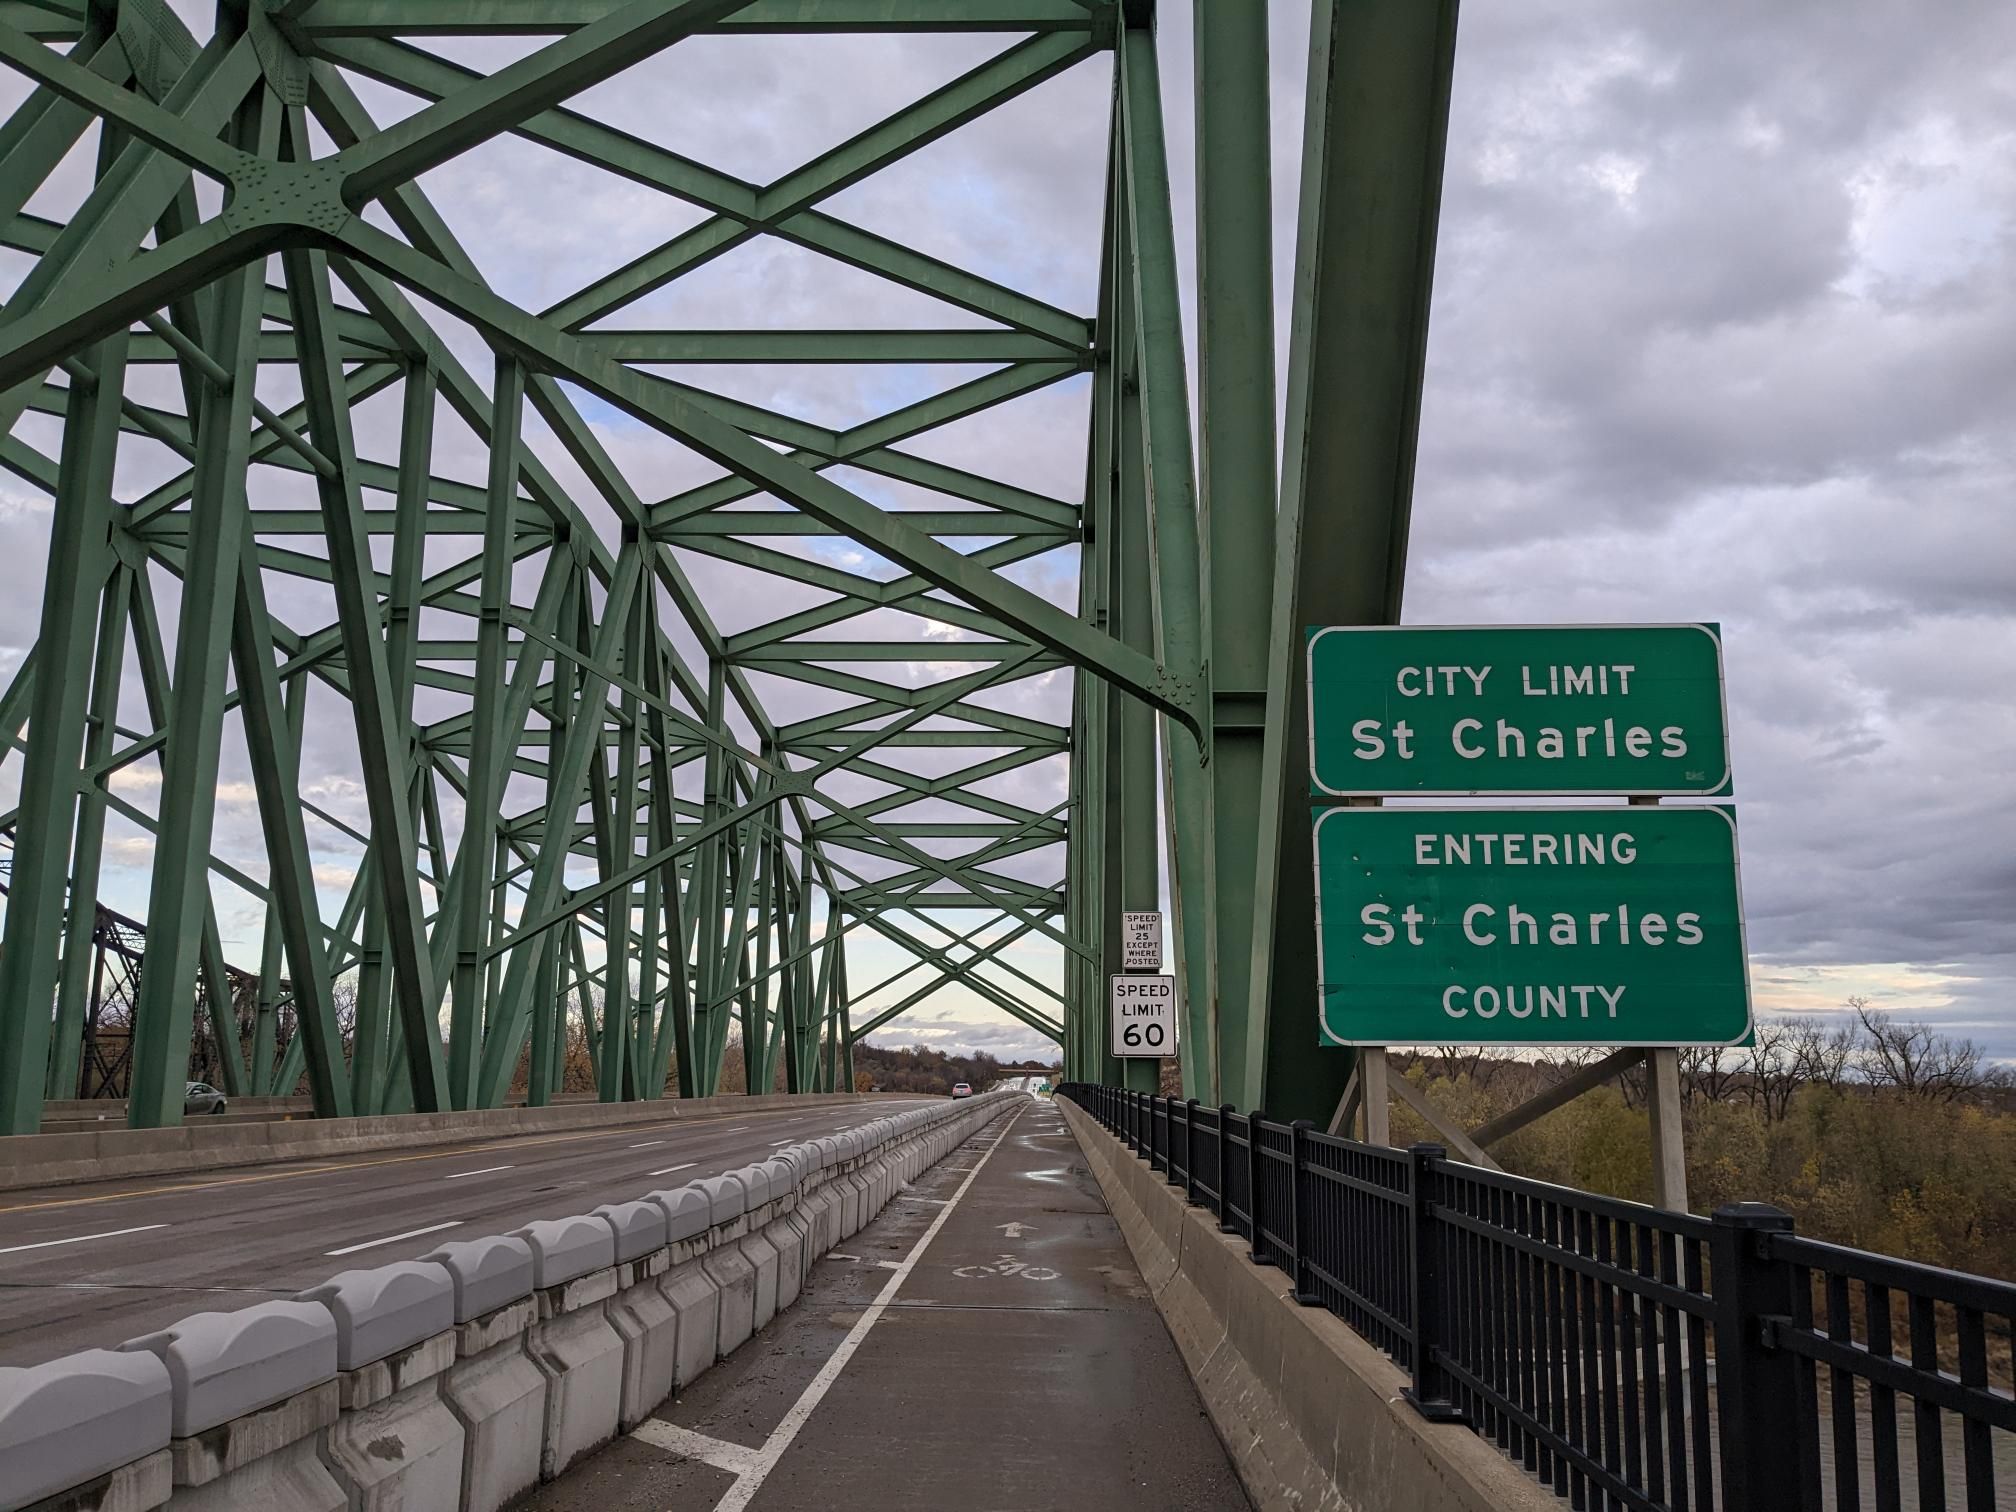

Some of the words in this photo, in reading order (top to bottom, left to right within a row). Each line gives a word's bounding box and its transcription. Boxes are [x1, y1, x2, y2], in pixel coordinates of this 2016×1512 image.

[1397, 666, 1492, 697] CITY
[1522, 665, 1635, 696] LIMIT
[1352, 719, 1414, 760] St
[1452, 718, 1688, 759] Charles
[1415, 833, 1637, 865] ENTERING
[1127, 914, 1157, 922] SPEED
[1360, 903, 1424, 946] St
[1463, 903, 1703, 946] Charles
[1135, 932, 1149, 940] 25
[1117, 985, 1170, 997] SPEED
[1442, 985, 1626, 1019] COUNTY
[1122, 1003, 1164, 1016] LIMIT
[1123, 1023, 1164, 1047] 60
